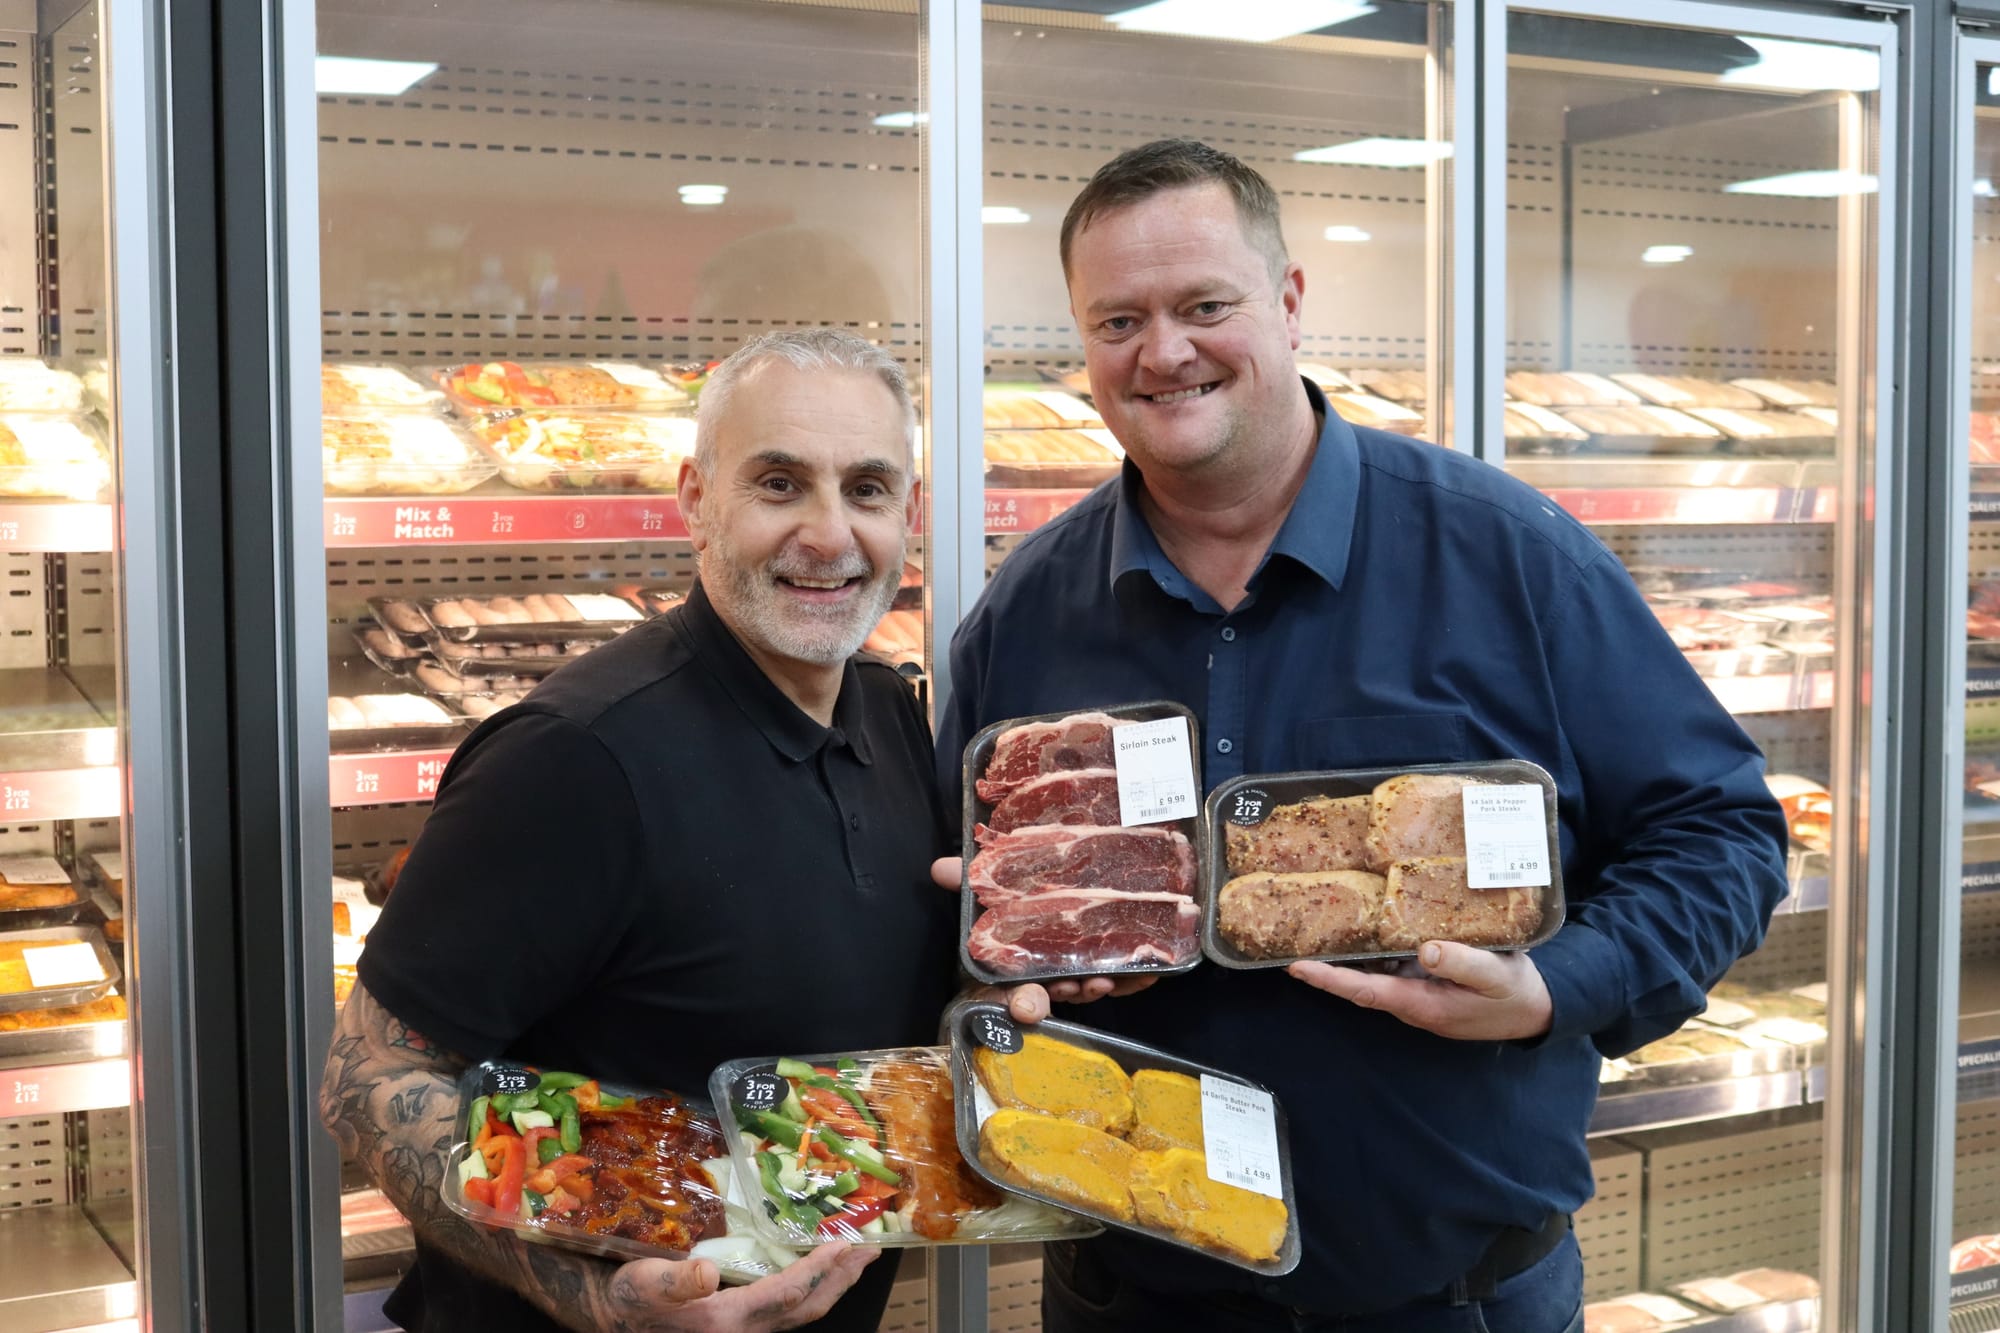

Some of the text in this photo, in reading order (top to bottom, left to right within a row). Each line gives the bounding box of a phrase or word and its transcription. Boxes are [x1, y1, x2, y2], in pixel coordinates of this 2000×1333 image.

[984, 500, 1016, 512] ix &
[334, 512, 340, 525] 3
[395, 506, 452, 522] Mix &
[492, 511, 500, 522] 3
[642, 509, 650, 520] 3
[492, 522, 513, 532] £12
[642, 519, 662, 530] £12
[984, 514, 1018, 528] atch
[333, 524, 356, 536] £12
[394, 523, 454, 538] Match
[1120, 735, 1176, 750] Sirloin Steak
[356, 770, 362, 782] 3
[4, 786, 12, 798] 3
[356, 781, 378, 793] £12
[6, 797, 30, 810] £12
[1168, 794, 1185, 805] 9.99
[1236, 796, 1244, 806] 3
[1234, 806, 1260, 816] £12
[985, 1020, 1011, 1036] 3 FOR
[987, 1031, 1011, 1046] £12
[15, 1081, 22, 1092] 3
[746, 1080, 755, 1090] 3
[15, 1091, 39, 1104] £12
[746, 1090, 774, 1100] £12
[1254, 1170, 1270, 1180] 4.99
[1950, 1278, 1998, 1298] PECIALIST
